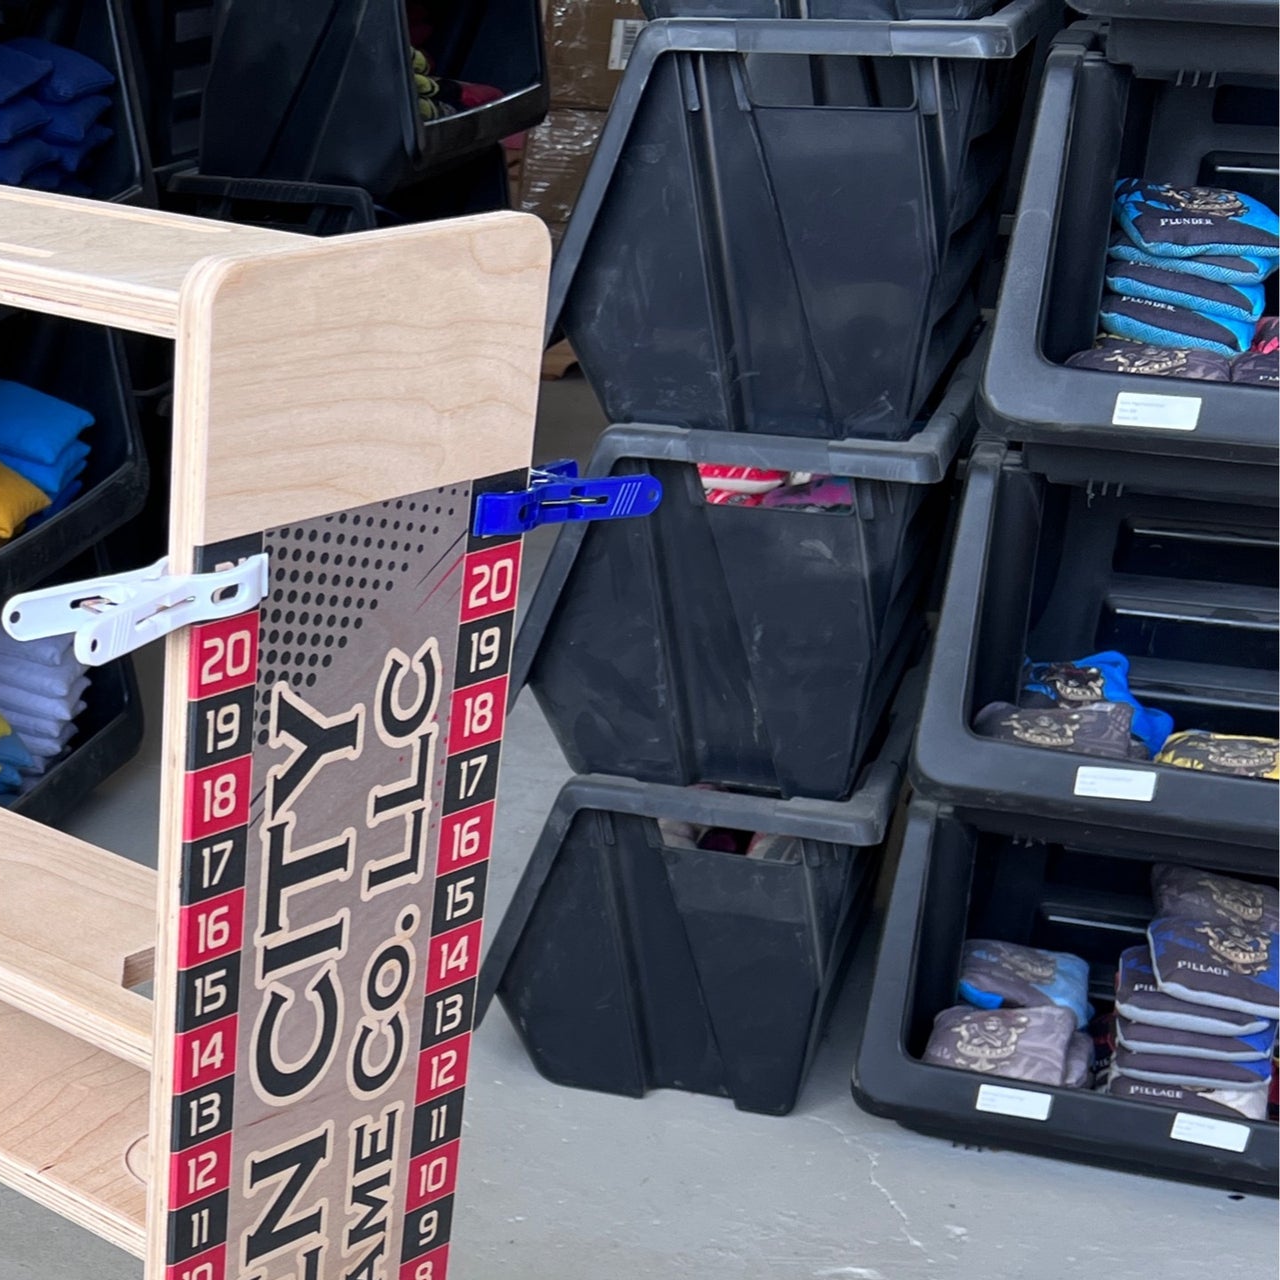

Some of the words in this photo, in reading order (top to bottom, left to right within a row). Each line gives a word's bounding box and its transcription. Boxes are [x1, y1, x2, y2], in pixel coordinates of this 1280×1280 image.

[1159, 217, 1214, 227] PLUNDER
[468, 558, 513, 609] 20
[201, 630, 251, 685] 20
[469, 626, 501, 673] 19
[206, 703, 241, 754] 19
[463, 692, 494, 737] 18
[366, 645, 438, 895] LLC
[459, 754, 488, 800] 17
[203, 773, 236, 822] 18
[452, 816, 481, 861] 16
[202, 839, 234, 889] 17
[253, 689, 360, 1098] CITY
[445, 876, 475, 921] 15
[198, 905, 230, 953] 16
[440, 935, 469, 979] 14
[1176, 960, 1230, 978] PILLAGE
[194, 968, 227, 1017] 15
[351, 911, 416, 1093] CO.
[435, 993, 463, 1036] 13
[191, 1031, 224, 1078] 14
[430, 1049, 457, 1090] 12
[189, 1092, 221, 1137] 13
[1128, 1085, 1184, 1099] PILLAGE
[430, 1104, 447, 1142] 11
[188, 1151, 217, 1194] 12
[419, 1156, 447, 1197] 10
[191, 1208, 209, 1248] 11
[418, 1209, 439, 1246] 9
